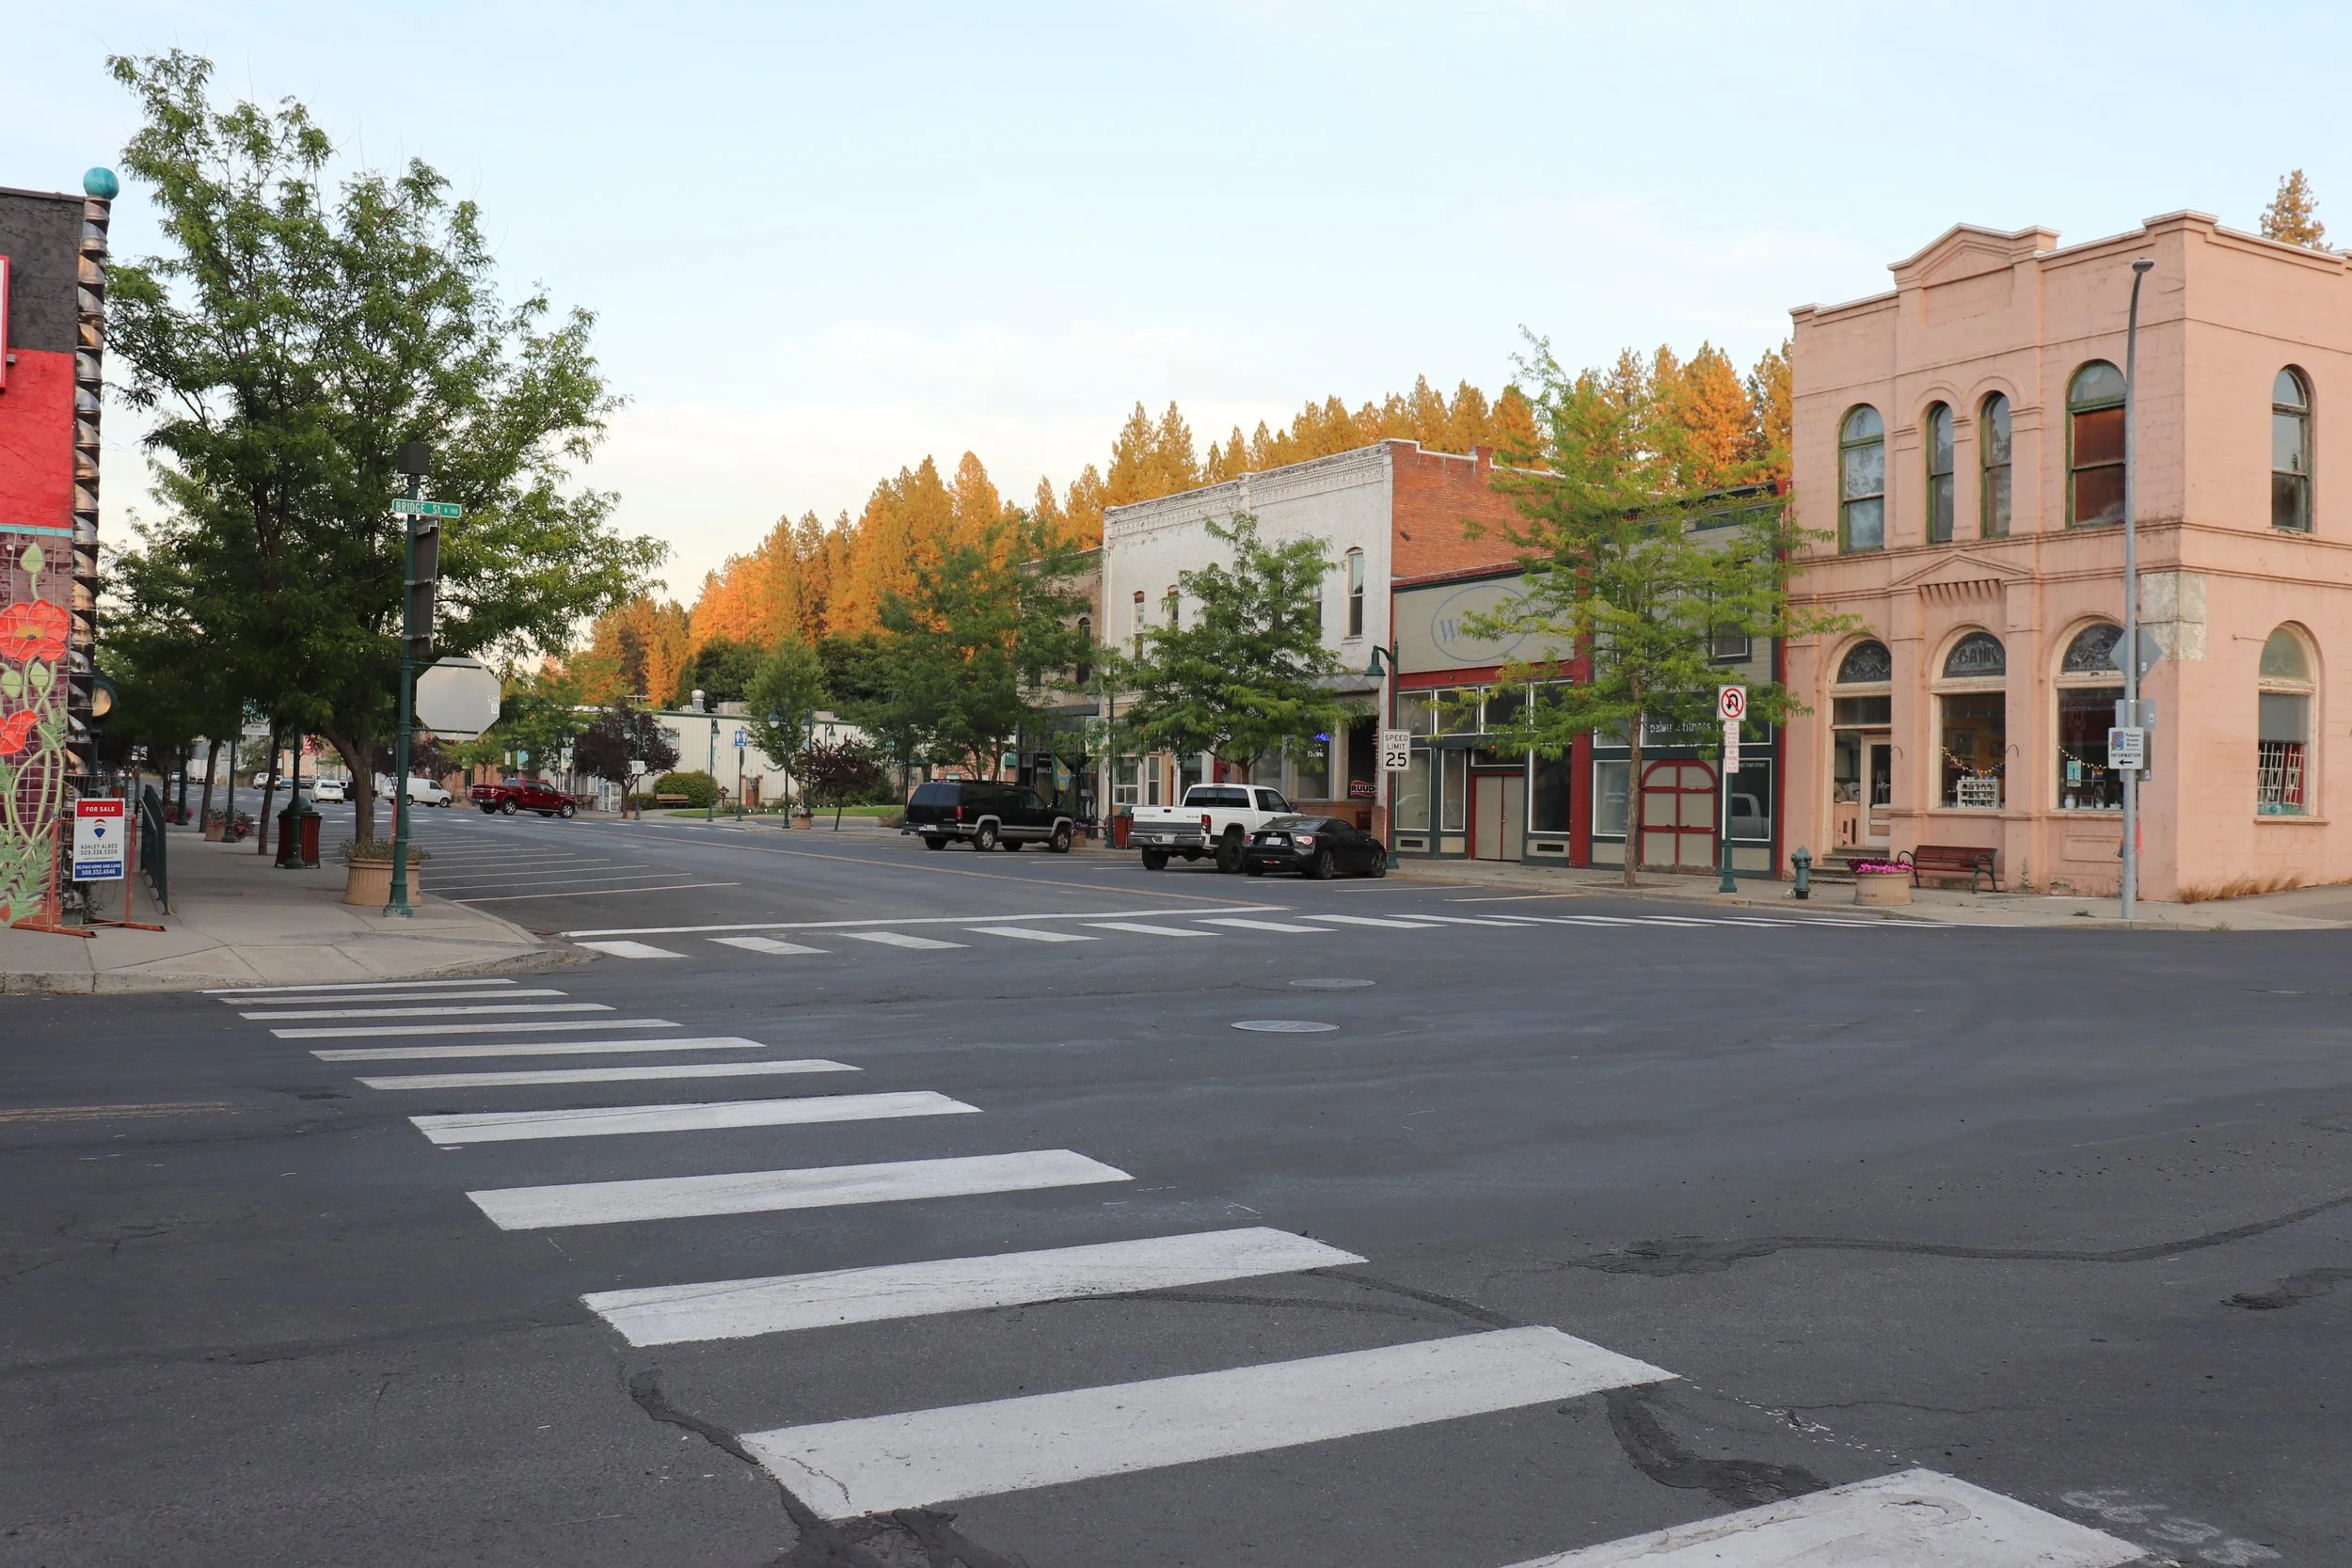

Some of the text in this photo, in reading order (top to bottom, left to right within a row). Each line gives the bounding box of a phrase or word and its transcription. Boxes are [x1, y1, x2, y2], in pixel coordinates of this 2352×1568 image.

[395, 500, 425, 514] BRIDGE
[432, 504, 441, 514] St
[1959, 646, 2001, 665] BANK
[1682, 722, 1710, 732] fitns
[1385, 752, 1406, 767] 25
[1351, 784, 1375, 793] RUUD
